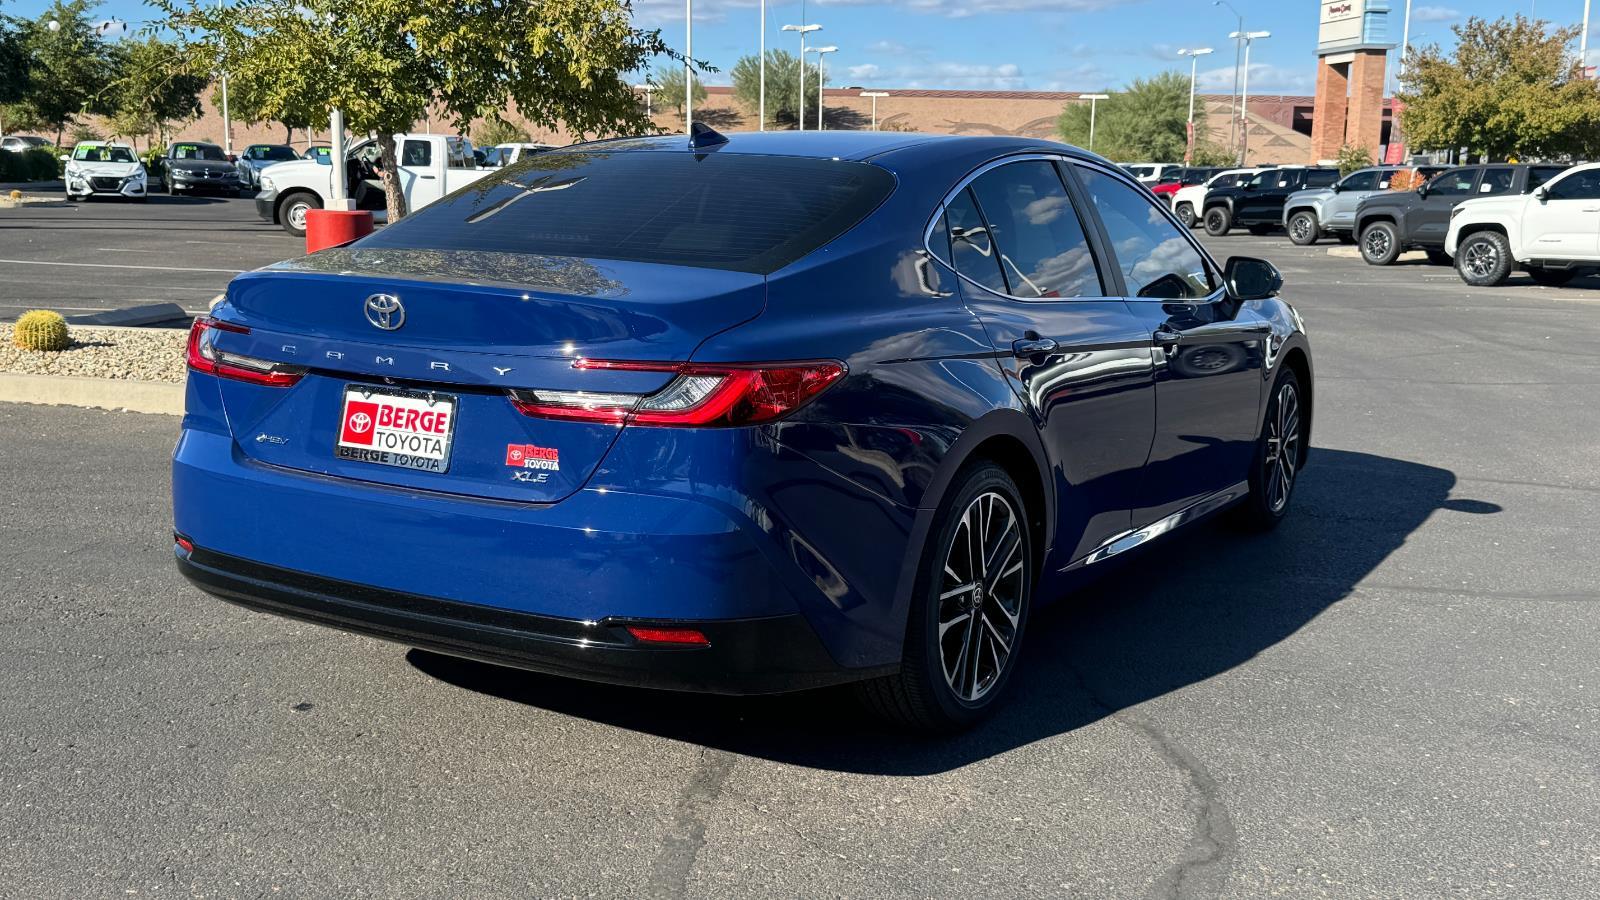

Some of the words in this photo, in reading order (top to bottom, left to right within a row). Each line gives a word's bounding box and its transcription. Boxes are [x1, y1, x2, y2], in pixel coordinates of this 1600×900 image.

[282, 345, 515, 376] CAMRY
[378, 404, 448, 434] BERGE
[376, 431, 443, 455] TOYOTA
[524, 444, 559, 461] BERGE
[340, 446, 389, 463] BERGE
[393, 453, 440, 470] TOYOTA
[523, 459, 560, 471] TOYOTA
[511, 471, 550, 483] XLE
